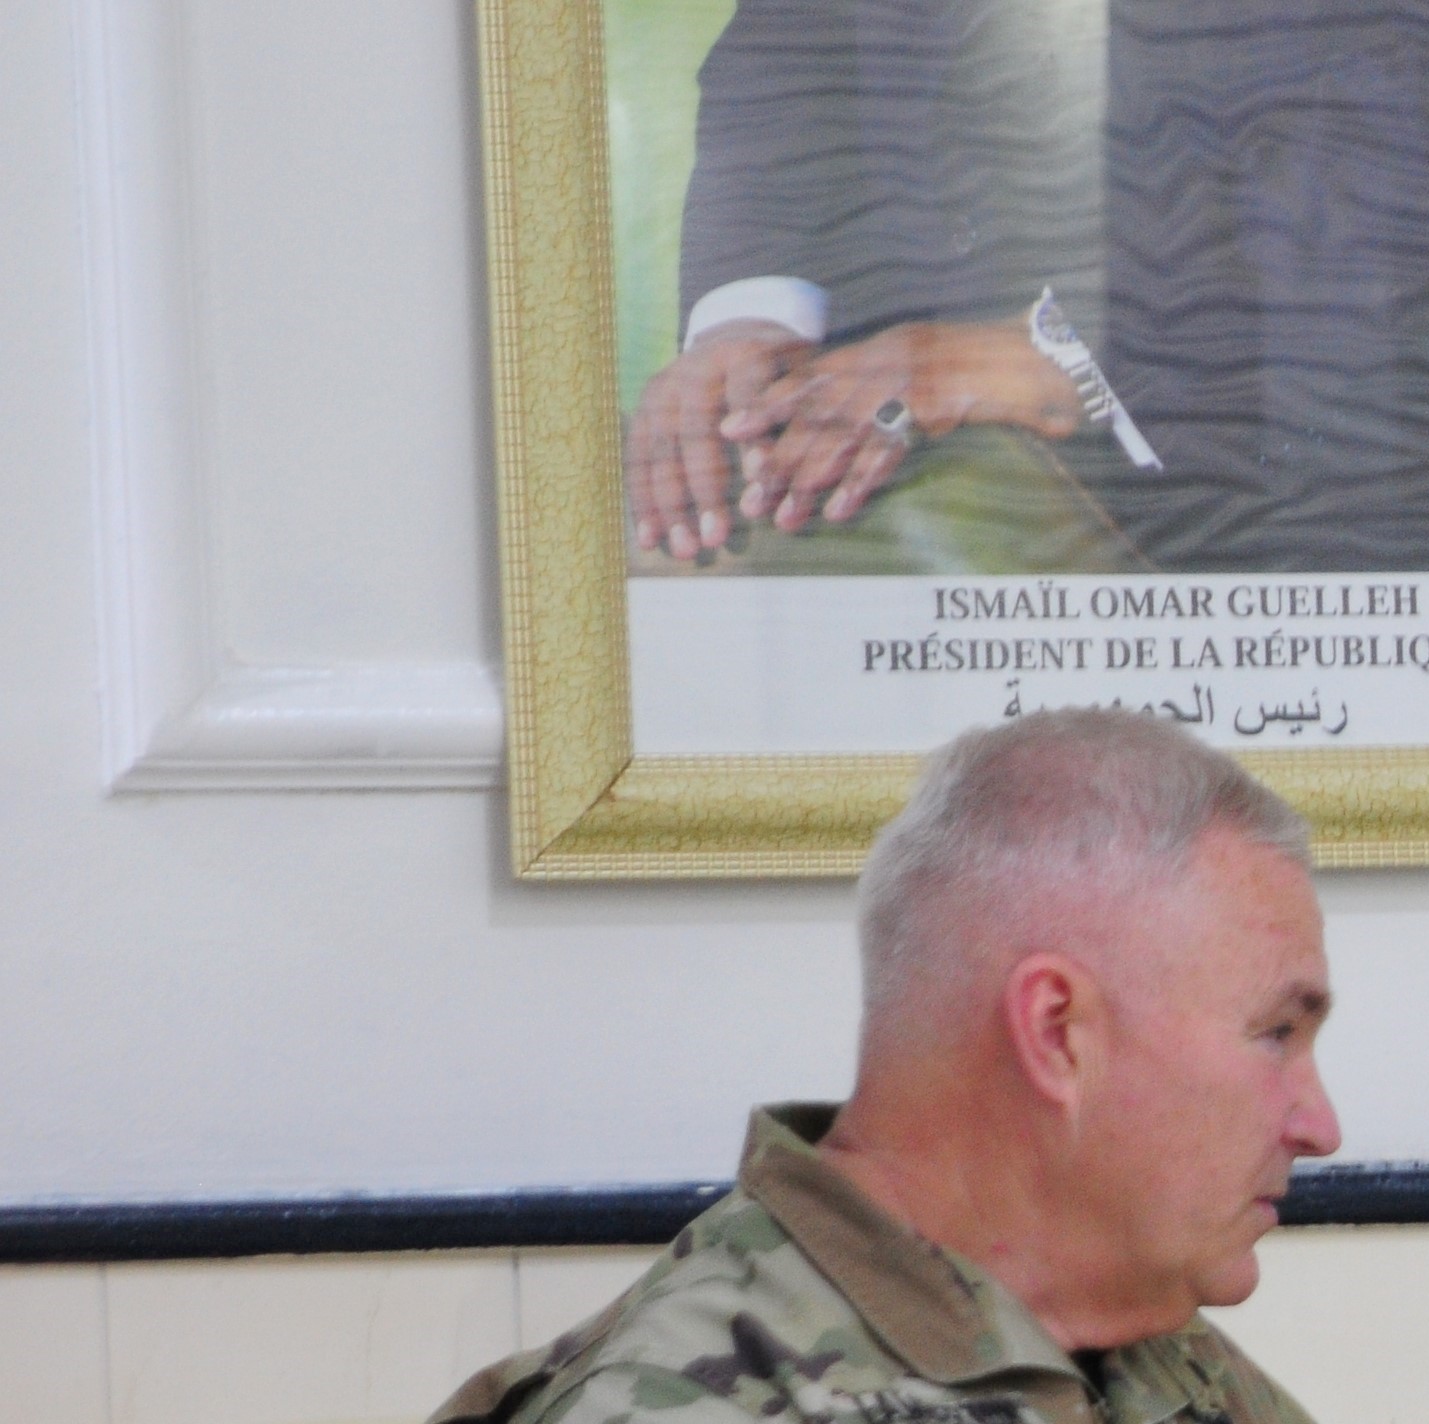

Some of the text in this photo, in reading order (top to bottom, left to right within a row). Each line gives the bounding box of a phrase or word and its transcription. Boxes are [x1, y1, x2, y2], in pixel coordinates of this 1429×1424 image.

[934, 580, 1420, 620] ISMAÏL OMAR GUELLEH
[862, 631, 1093, 671] PRÉSIDENT
[1105, 636, 1159, 669] DE
[1170, 636, 1224, 668] LA
[1234, 686, 1349, 736] رئيس
